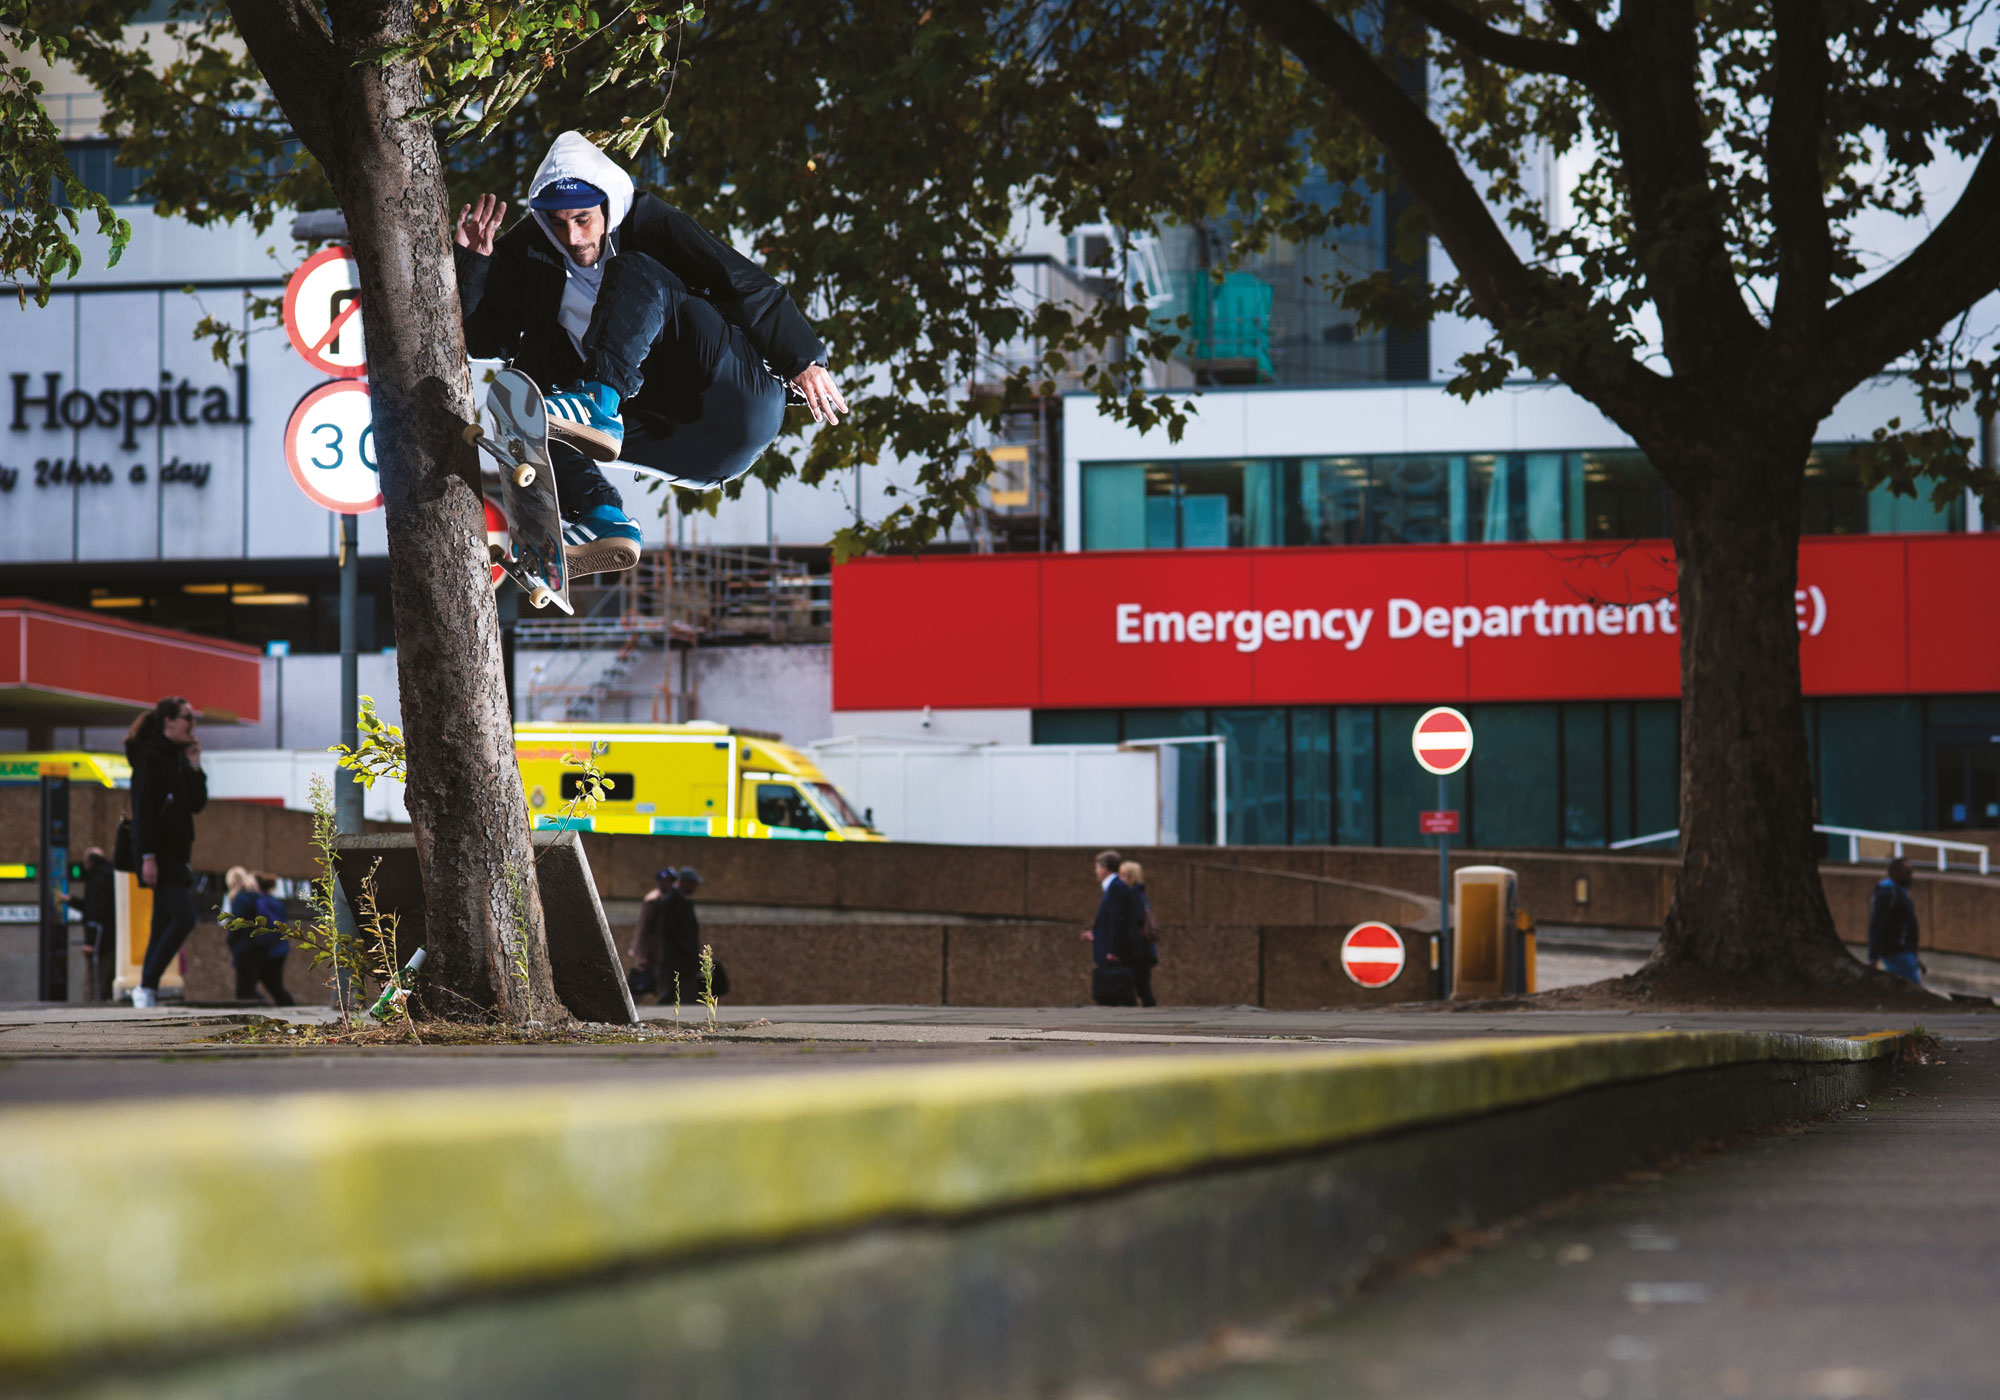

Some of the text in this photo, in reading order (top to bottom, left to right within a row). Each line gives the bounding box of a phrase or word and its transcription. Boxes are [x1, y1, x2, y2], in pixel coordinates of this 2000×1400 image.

[10, 363, 252, 451] Hospital
[128, 463, 147, 485] a
[159, 455, 211, 489] day
[1115, 597, 1678, 653] Emergency Department
